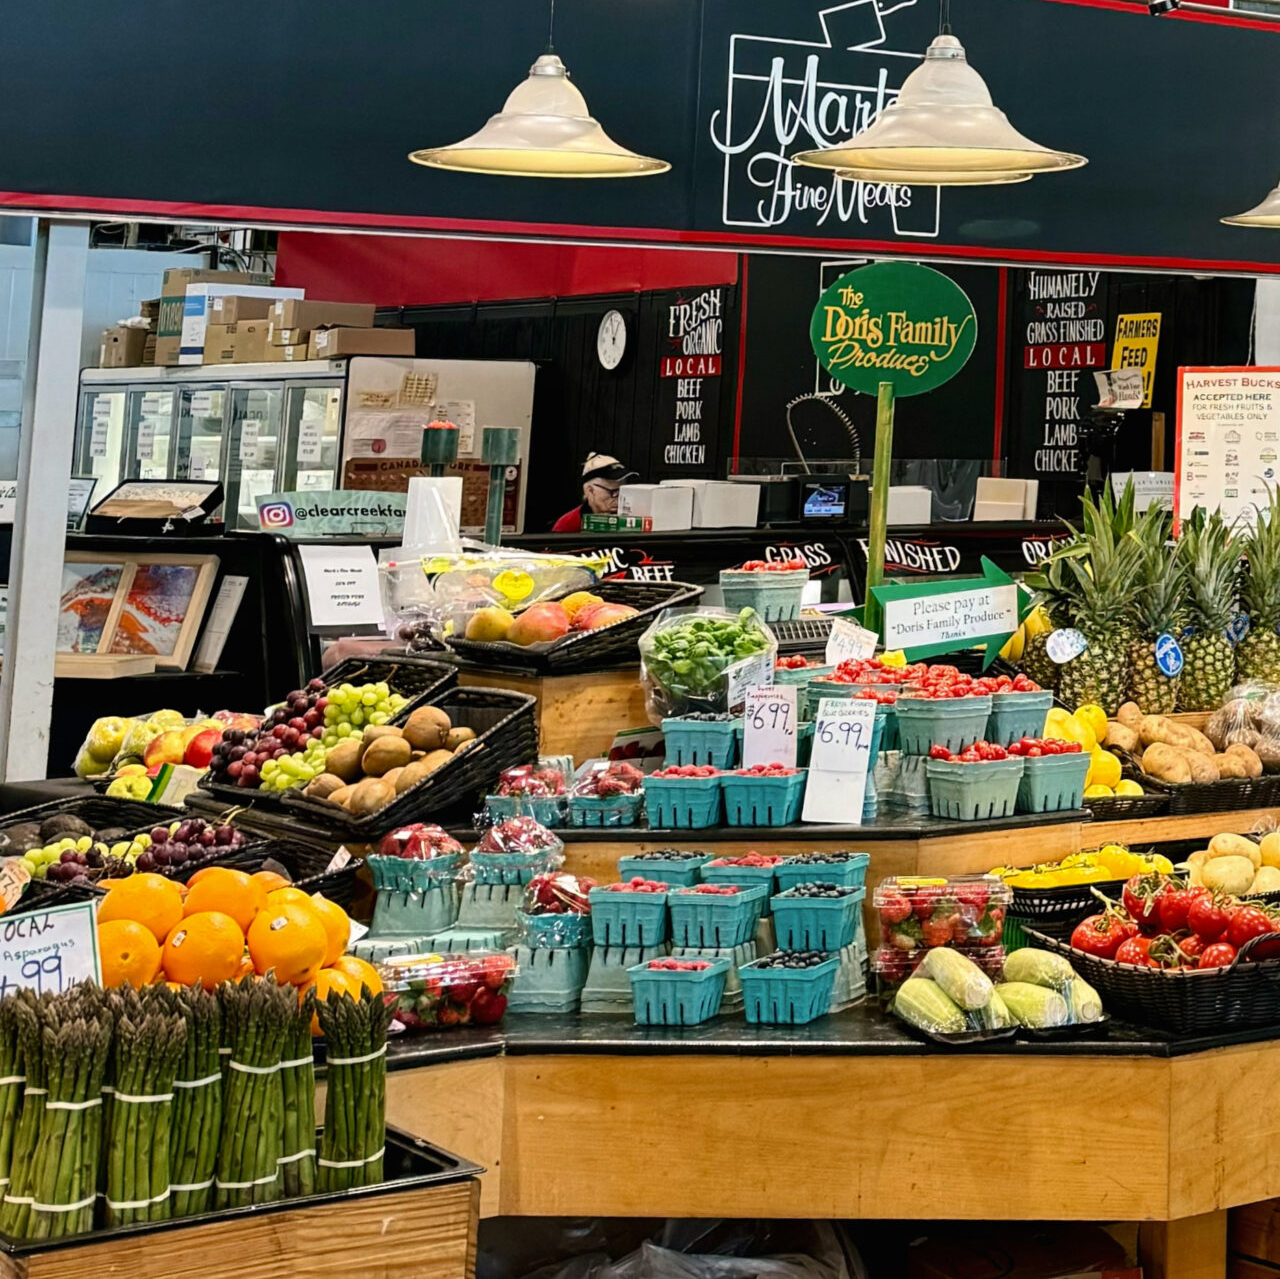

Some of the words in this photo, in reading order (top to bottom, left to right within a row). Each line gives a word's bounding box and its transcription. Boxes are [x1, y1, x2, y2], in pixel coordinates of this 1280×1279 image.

[747, 151, 828, 226] Fine
[817, 171, 912, 226] Meats
[837, 285, 864, 309] The
[1028, 271, 1100, 301] HUMANELY
[669, 288, 721, 337] FRESH
[1046, 302, 1086, 319] RAISED
[682, 318, 723, 356] ORGANIC
[821, 306, 884, 348] Doris
[886, 310, 972, 361] Family
[1027, 322, 1058, 344] GRASS
[1060, 319, 1105, 343] FINISHED
[1116, 318, 1159, 342] FARMERS
[666, 357, 716, 376] LOCAL
[828, 340, 929, 377] Produce
[1029, 346, 1095, 366] LOCAL
[1121, 346, 1148, 369] FEED
[677, 378, 703, 398] BEEF
[1047, 370, 1080, 393] BEEF
[1186, 378, 1239, 390] HARVEST
[1193, 393, 1243, 401] ACCEPTED
[1245, 393, 1272, 401] HERE
[676, 401, 704, 420] PORK
[1045, 397, 1080, 420] PORK
[674, 422, 700, 442] LAMB
[1043, 424, 1078, 446] LAMB
[664, 445, 706, 464] CHICKEN
[1034, 449, 1079, 471] CHICKE
[449, 462, 472, 472] ORK
[856, 538, 961, 572] FNISHED
[630, 565, 675, 582] BEEF
[913, 600, 950, 615] Please
[954, 598, 975, 613] pay
[978, 595, 991, 606] at
[927, 616, 961, 630] Family
[941, 630, 966, 639] Thanks
[0, 913, 54, 942] OCAL
[3, 938, 76, 962] Asparagus
